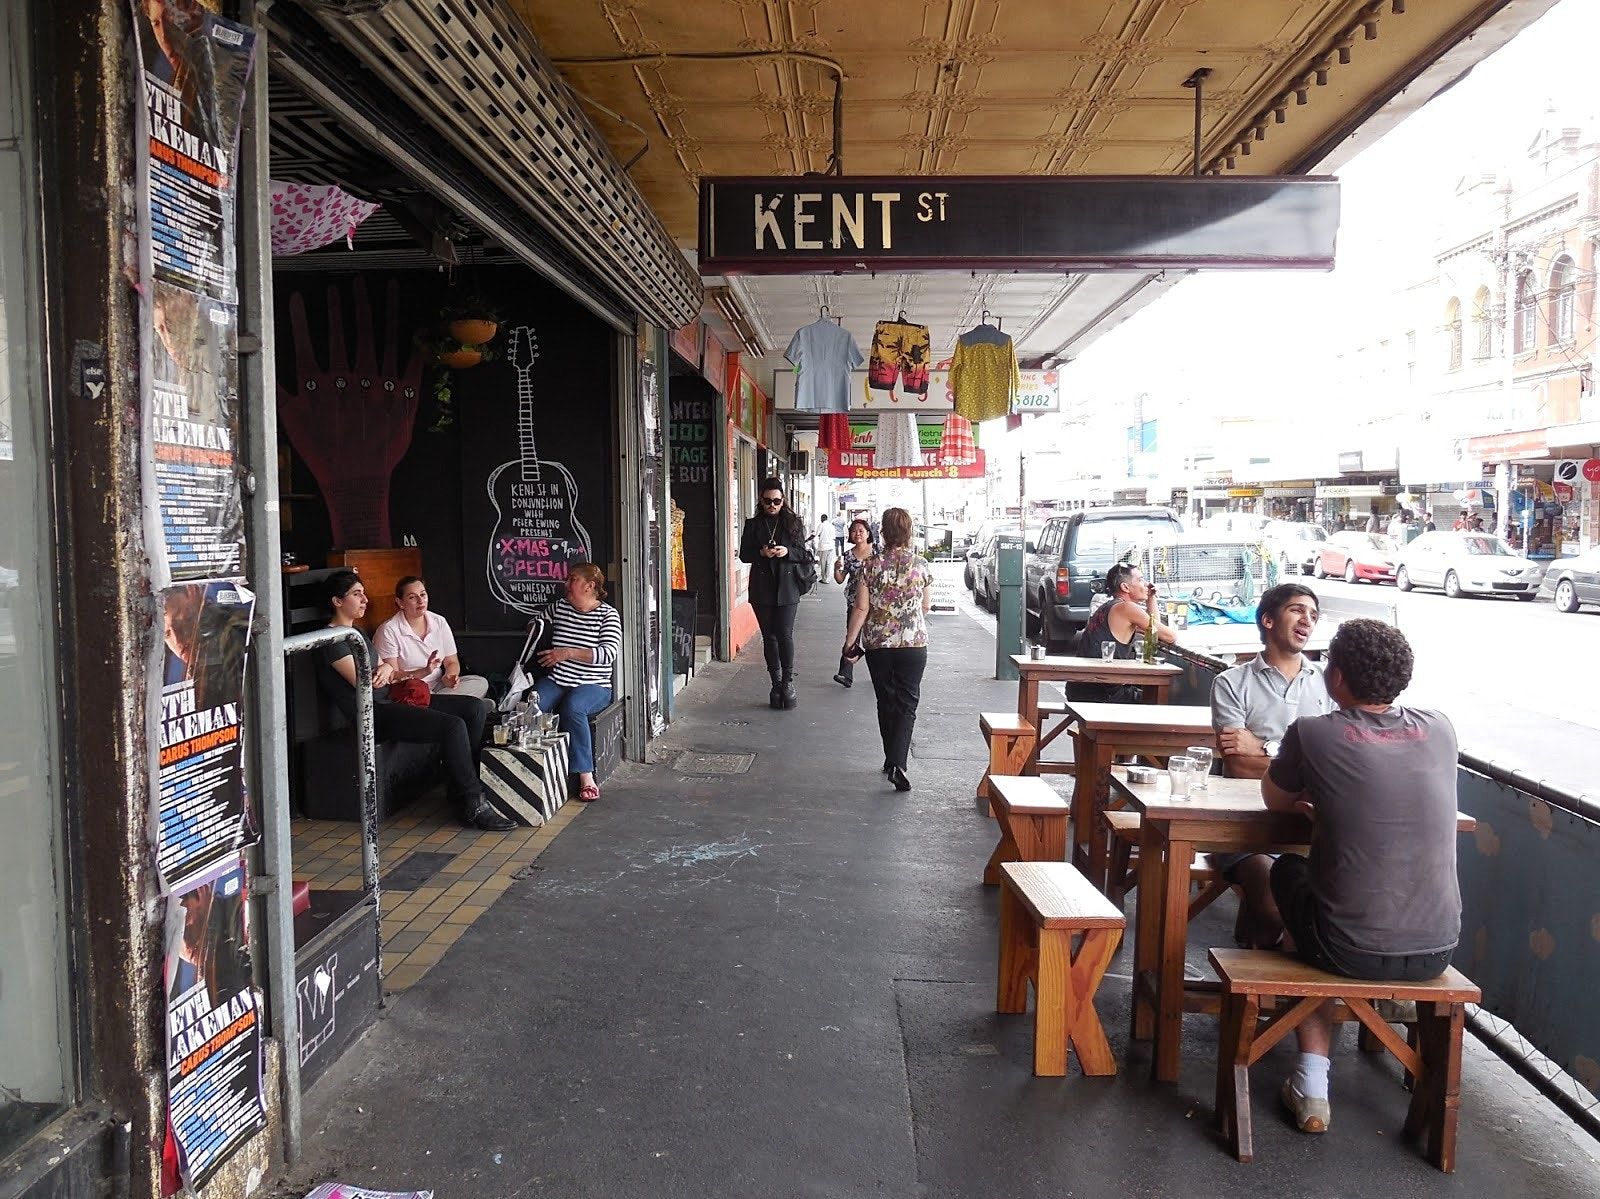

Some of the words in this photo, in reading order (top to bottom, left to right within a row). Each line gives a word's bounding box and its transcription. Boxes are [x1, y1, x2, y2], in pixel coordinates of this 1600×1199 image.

[755, 193, 900, 249] KENT
[917, 193, 949, 222] ST
[1022, 395, 1050, 406] 8182
[671, 446, 709, 464] TAGE
[841, 453, 869, 466] DINE
[680, 466, 709, 483] BUY
[856, 467, 900, 478] Special
[906, 467, 943, 477] Lunch
[550, 484, 559, 496] IN
[536, 519, 560, 529] EWING
[510, 583, 557, 594] WEDNESDAY
[160, 742, 190, 766] CARUS
[190, 726, 238, 756] THOMPSON
[170, 986, 253, 1068] AKEMAN
